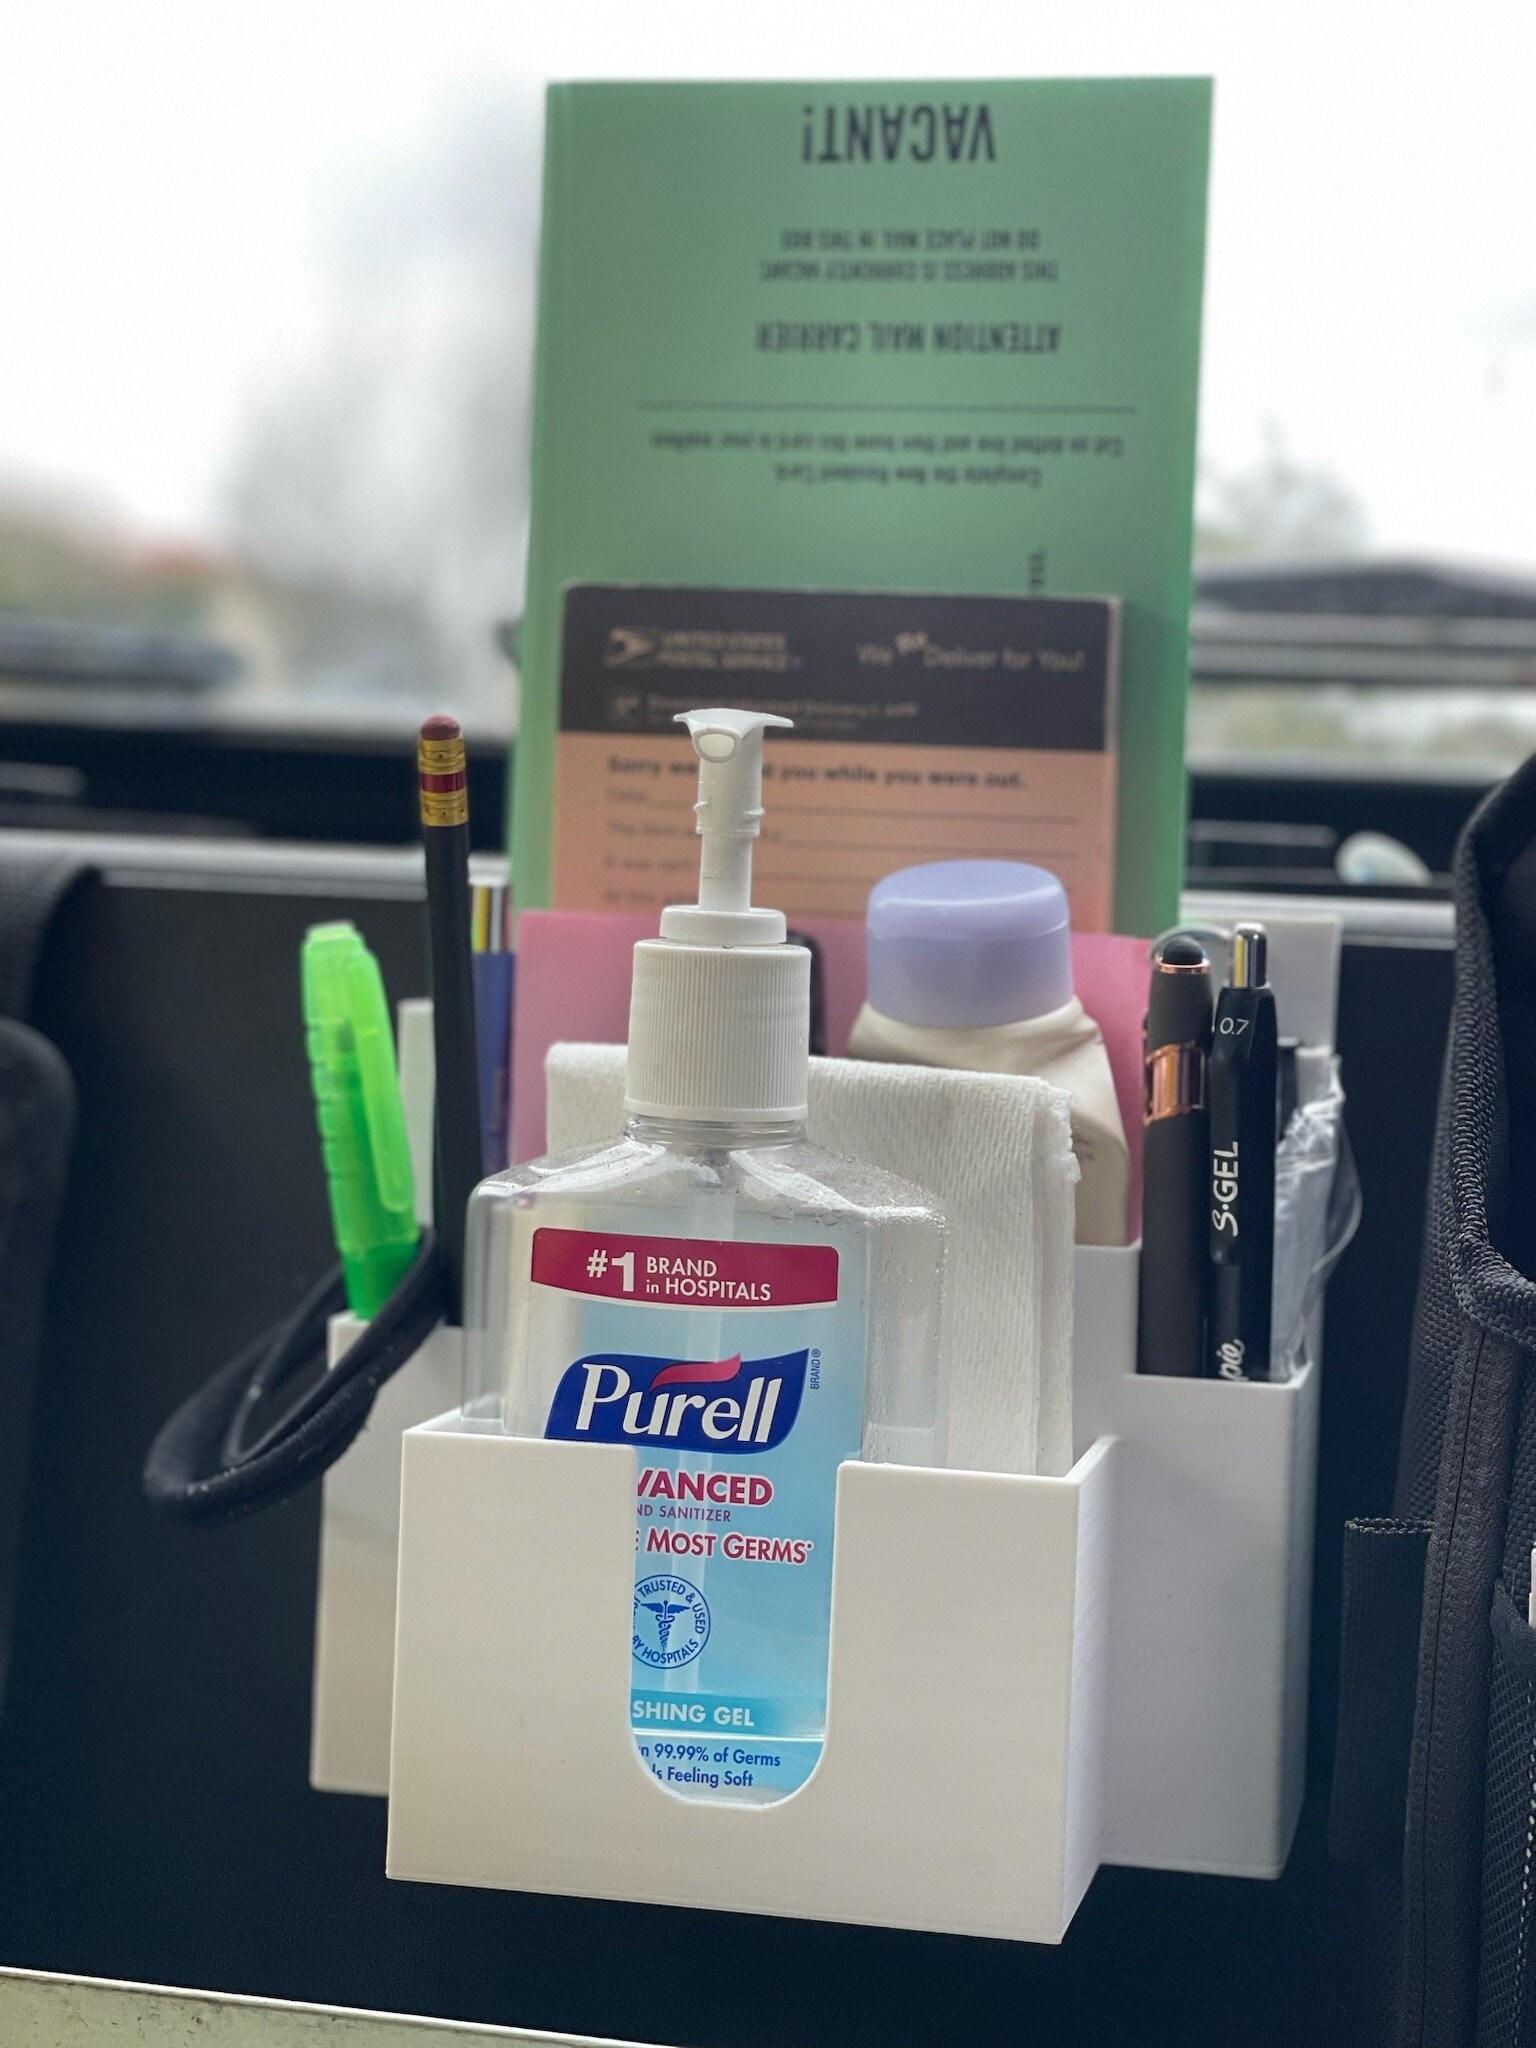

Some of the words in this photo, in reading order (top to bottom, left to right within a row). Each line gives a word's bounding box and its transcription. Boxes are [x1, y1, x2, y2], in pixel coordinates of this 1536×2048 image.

[801, 104, 997, 163] VACANT!
[818, 229, 853, 250] THIS
[882, 229, 919, 250] MAIL
[925, 229, 976, 250] PLACE
[981, 229, 1011, 250] NOT
[825, 260, 917, 282] CURRENTLY
[943, 260, 1016, 282] ADDRESS
[756, 320, 861, 353] CARRIER
[870, 321, 925, 353] MAIL
[934, 321, 1062, 354] ATTENTION
[965, 466, 1042, 489] Complete
[607, 757, 661, 779] Sorry
[780, 765, 816, 780] you
[823, 764, 877, 781] while
[884, 770, 921, 788] you
[927, 771, 979, 786] were
[1219, 1016, 1250, 1036] 0.7
[587, 1250, 635, 1292] #1
[646, 1256, 718, 1277] BRAND
[645, 1280, 660, 1294] in
[665, 1278, 772, 1302] HOSPITALS
[575, 1363, 783, 1443] Purell
[659, 1505, 732, 1523] SANITIZER
[646, 1528, 718, 1557] MOST
[637, 1579, 686, 1598] TRUSTED
[685, 1592, 696, 1604] &
[692, 1603, 706, 1635] USED
[641, 1638, 699, 1665] HOSPITALS
[632, 1700, 707, 1723] SHING
[713, 1706, 755, 1727] GEL
[654, 1743, 710, 1762] 99.99%
[713, 1749, 730, 1763] of
[732, 1748, 782, 1768] Germs
[667, 1766, 719, 1789] Feeling
[723, 1770, 754, 1788] Soft
